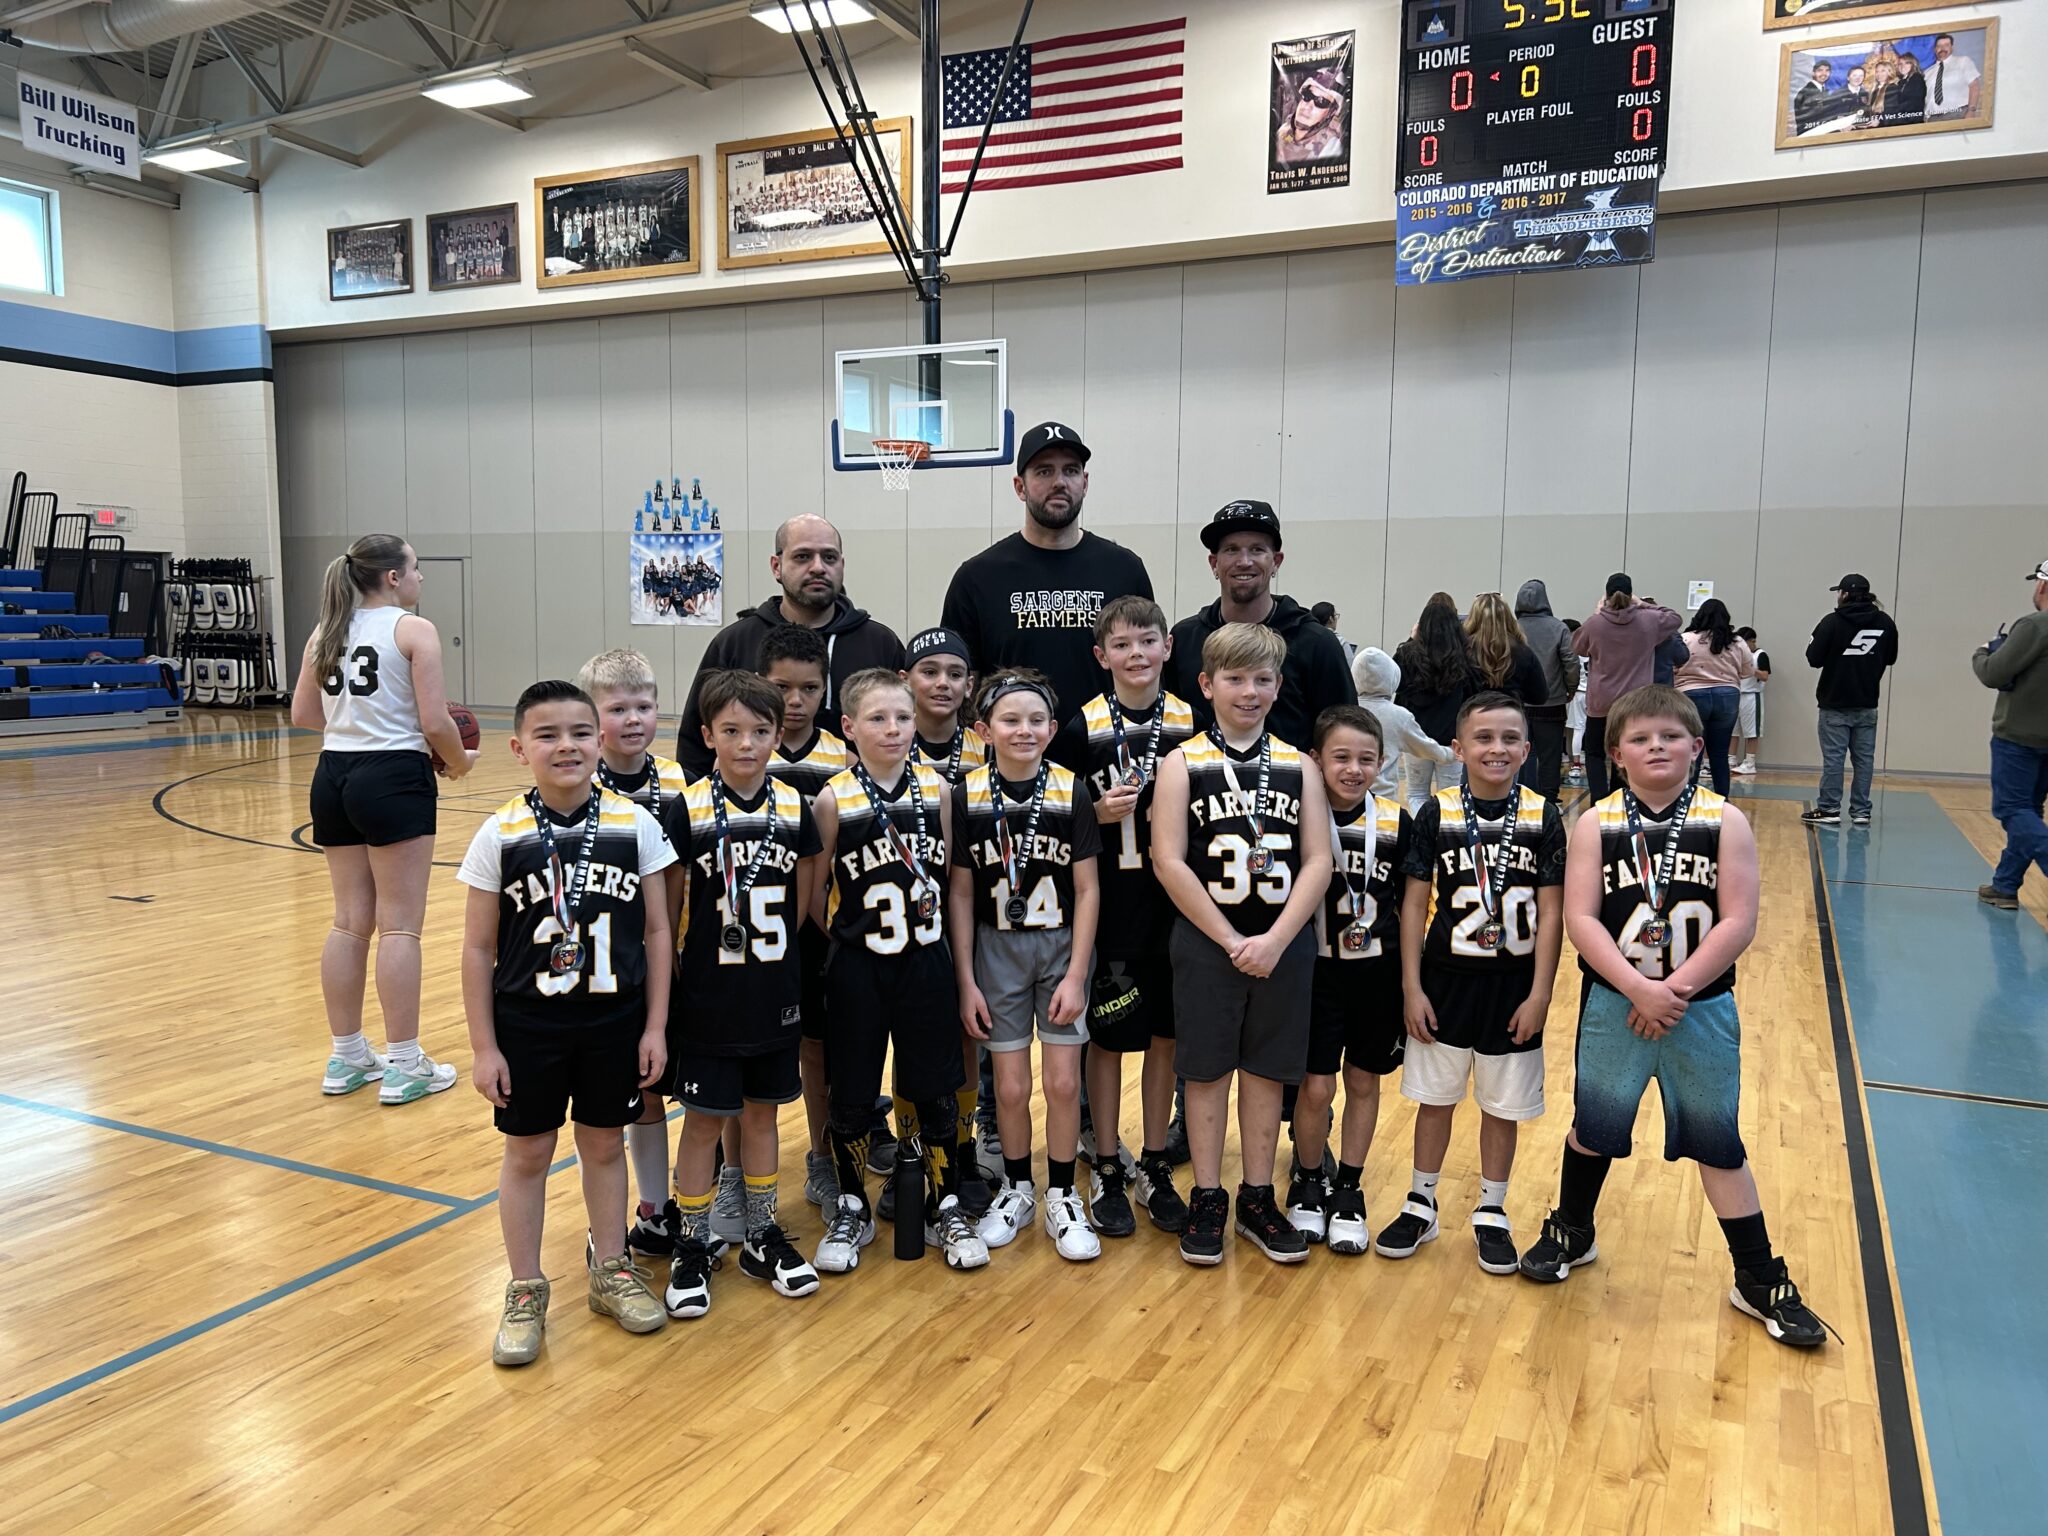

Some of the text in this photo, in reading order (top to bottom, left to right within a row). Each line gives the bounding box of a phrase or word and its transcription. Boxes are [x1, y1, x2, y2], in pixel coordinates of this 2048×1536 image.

[1307, 40, 1315, 50] OF
[1592, 17, 1658, 44] GUEST
[1418, 45, 1471, 70] HOME
[1509, 44, 1555, 62] PERIOD
[1631, 43, 1656, 87] 0
[1451, 70, 1474, 111] 0
[1520, 65, 1540, 98] 0
[21, 82, 135, 135] Bill Wilson
[1486, 102, 1574, 125] PLAYER FOUL
[1617, 90, 1661, 108] FOULS
[1406, 119, 1445, 136] FOULS
[1632, 108, 1653, 141] 0
[1803, 121, 1820, 129] 2015
[1885, 112, 1897, 120] Vet
[1897, 110, 1923, 119] Science
[34, 116, 126, 166] Trucking
[765, 150, 782, 160] DOWN
[788, 147, 796, 156] TO
[797, 146, 806, 154] GO
[813, 142, 826, 152] BALL
[828, 141, 835, 150] ON
[1420, 135, 1438, 166] 0
[1270, 163, 1348, 180] TRAVIS W. ANDERSON
[1400, 164, 1659, 207] COLORADO DEPARTMENT OF EDUCATION
[1404, 173, 1443, 188] SCORE
[1503, 160, 1547, 178] MATCH
[1411, 209, 1437, 221] 2015
[1447, 202, 1473, 216] 2016
[1501, 197, 1528, 210] 2016
[1539, 192, 1567, 207] 2017
[1400, 220, 1499, 261] District
[1514, 214, 1654, 237] THUNDERBIRDS
[1411, 244, 1566, 283] of Distinction
[1010, 590, 1105, 613] SARGENT
[1017, 610, 1097, 629] FARMERS
[1256, 741, 1271, 814] SECOND PLACE
[650, 782, 660, 815] PLACE
[910, 780, 924, 814] PLACE
[1019, 789, 1044, 869] SECOND PLACE
[1660, 806, 1687, 885] SECOND PLACE
[570, 818, 599, 907] SECOND PLACE
[742, 813, 776, 892] SECOND PLACE
[1207, 833, 1292, 905] 35
[1494, 813, 1515, 892] SECOND PLACE
[863, 876, 942, 955] 33
[991, 875, 1063, 931] 14
[716, 885, 787, 965] 15
[1451, 885, 1538, 958] 20
[533, 912, 618, 997] 31
[1616, 900, 1713, 978] 40
[1093, 987, 1139, 1018] UNDER
